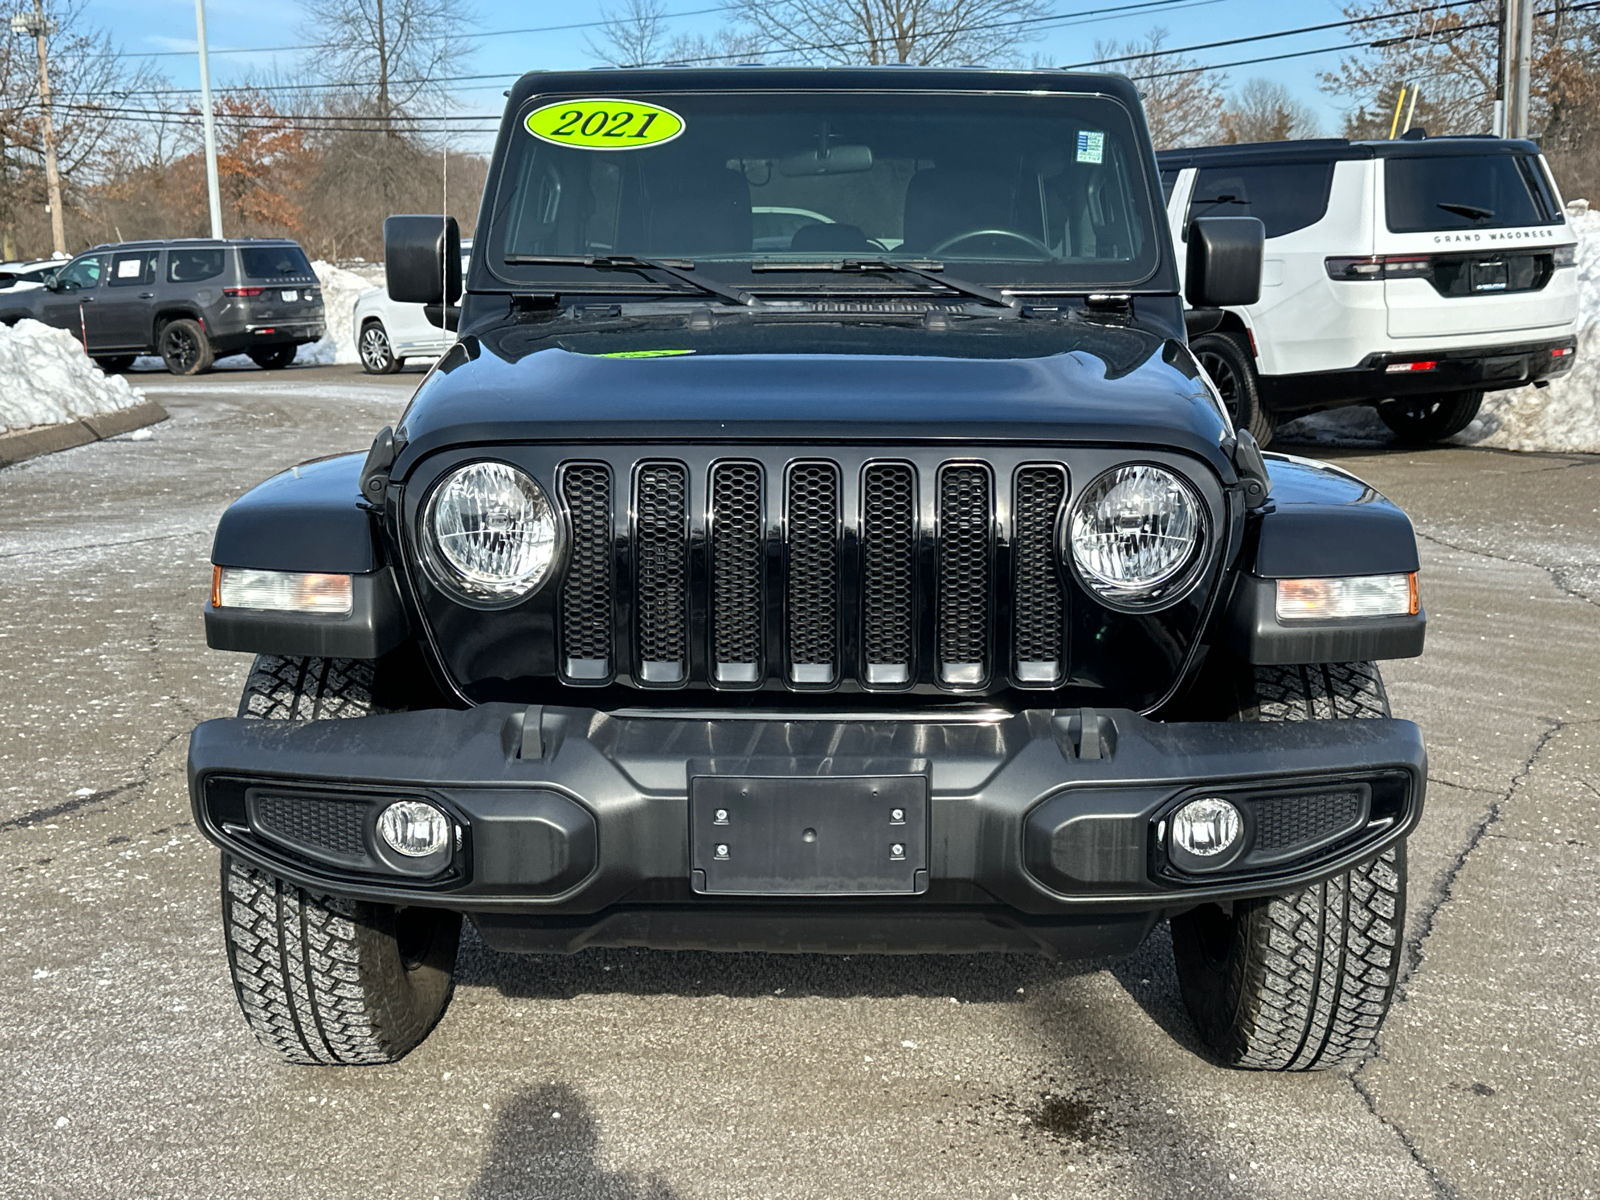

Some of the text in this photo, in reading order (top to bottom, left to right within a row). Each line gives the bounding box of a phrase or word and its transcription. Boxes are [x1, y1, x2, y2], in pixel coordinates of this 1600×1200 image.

[550, 110, 659, 138] 2021
[1433, 230, 1553, 244] GRAND WAGONEER
